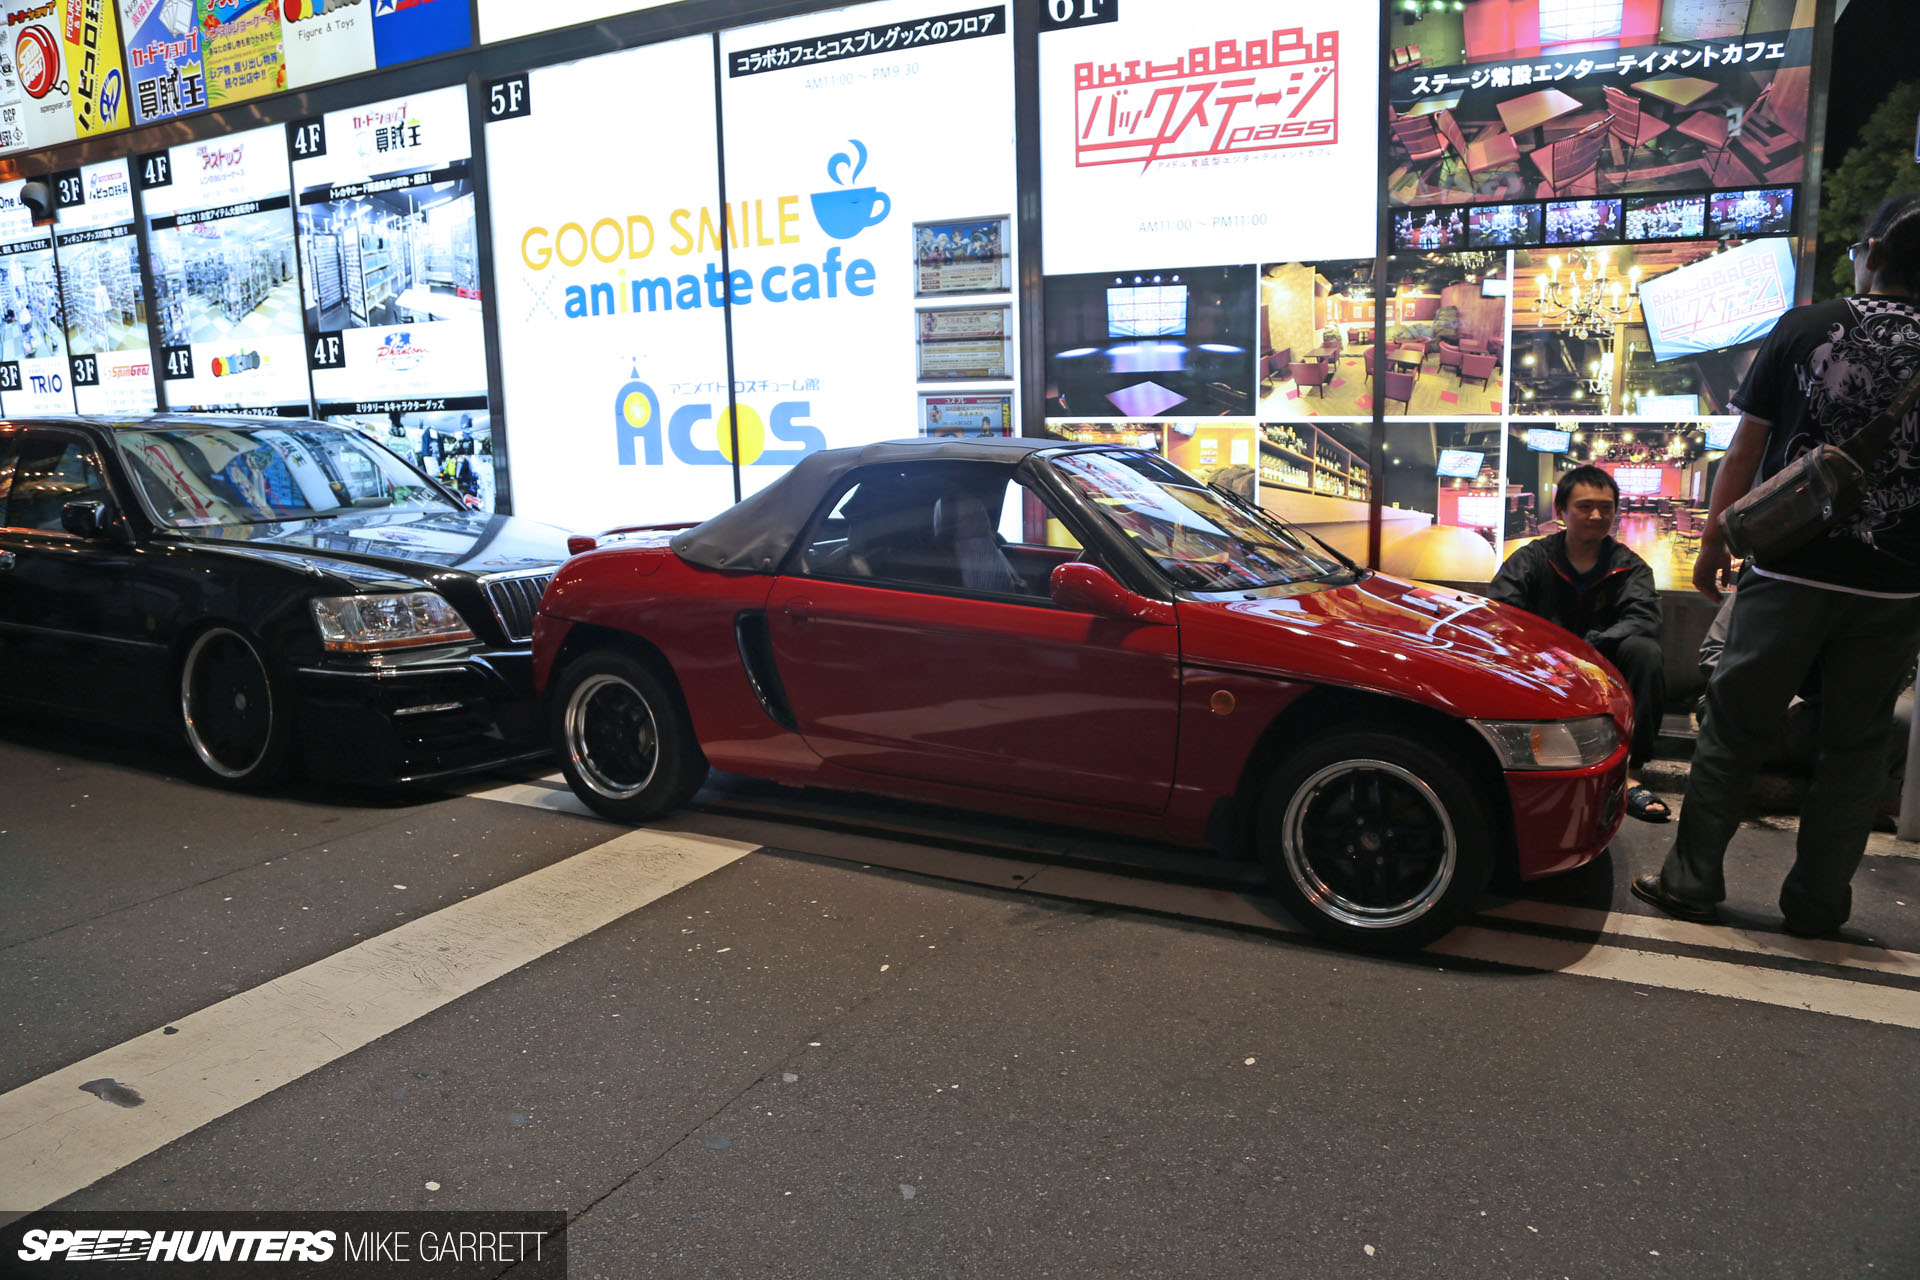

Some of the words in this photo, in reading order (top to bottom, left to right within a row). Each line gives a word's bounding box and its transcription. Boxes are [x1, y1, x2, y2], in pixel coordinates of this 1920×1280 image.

[298, 27, 323, 41] Figure
[326, 22, 332, 32] &
[335, 18, 355, 32] Toys
[737, 12, 996, 73] コラボカフェとコスプレグッズのフロア
[131, 26, 198, 67] カードショップ
[1410, 41, 1785, 95] ステージ常設エンターテイメントカフェ
[491, 80, 524, 116] 5F
[1081, 66, 1336, 158] バックステージ
[353, 102, 407, 129] カードショップ
[295, 124, 321, 154] 4F
[1224, 119, 1334, 150] pass
[144, 156, 168, 184] 4F
[59, 177, 80, 203] 3F
[521, 213, 655, 271] GOOD
[669, 194, 800, 256] SMILE
[564, 262, 753, 319] animate
[760, 246, 877, 304] cafe
[168, 350, 189, 375] 4F
[313, 336, 340, 365] 4F
[0, 365, 18, 388] 3F
[30, 373, 63, 394] TRIO
[74, 358, 95, 382] 3F
[614, 380, 827, 466] ACOS
